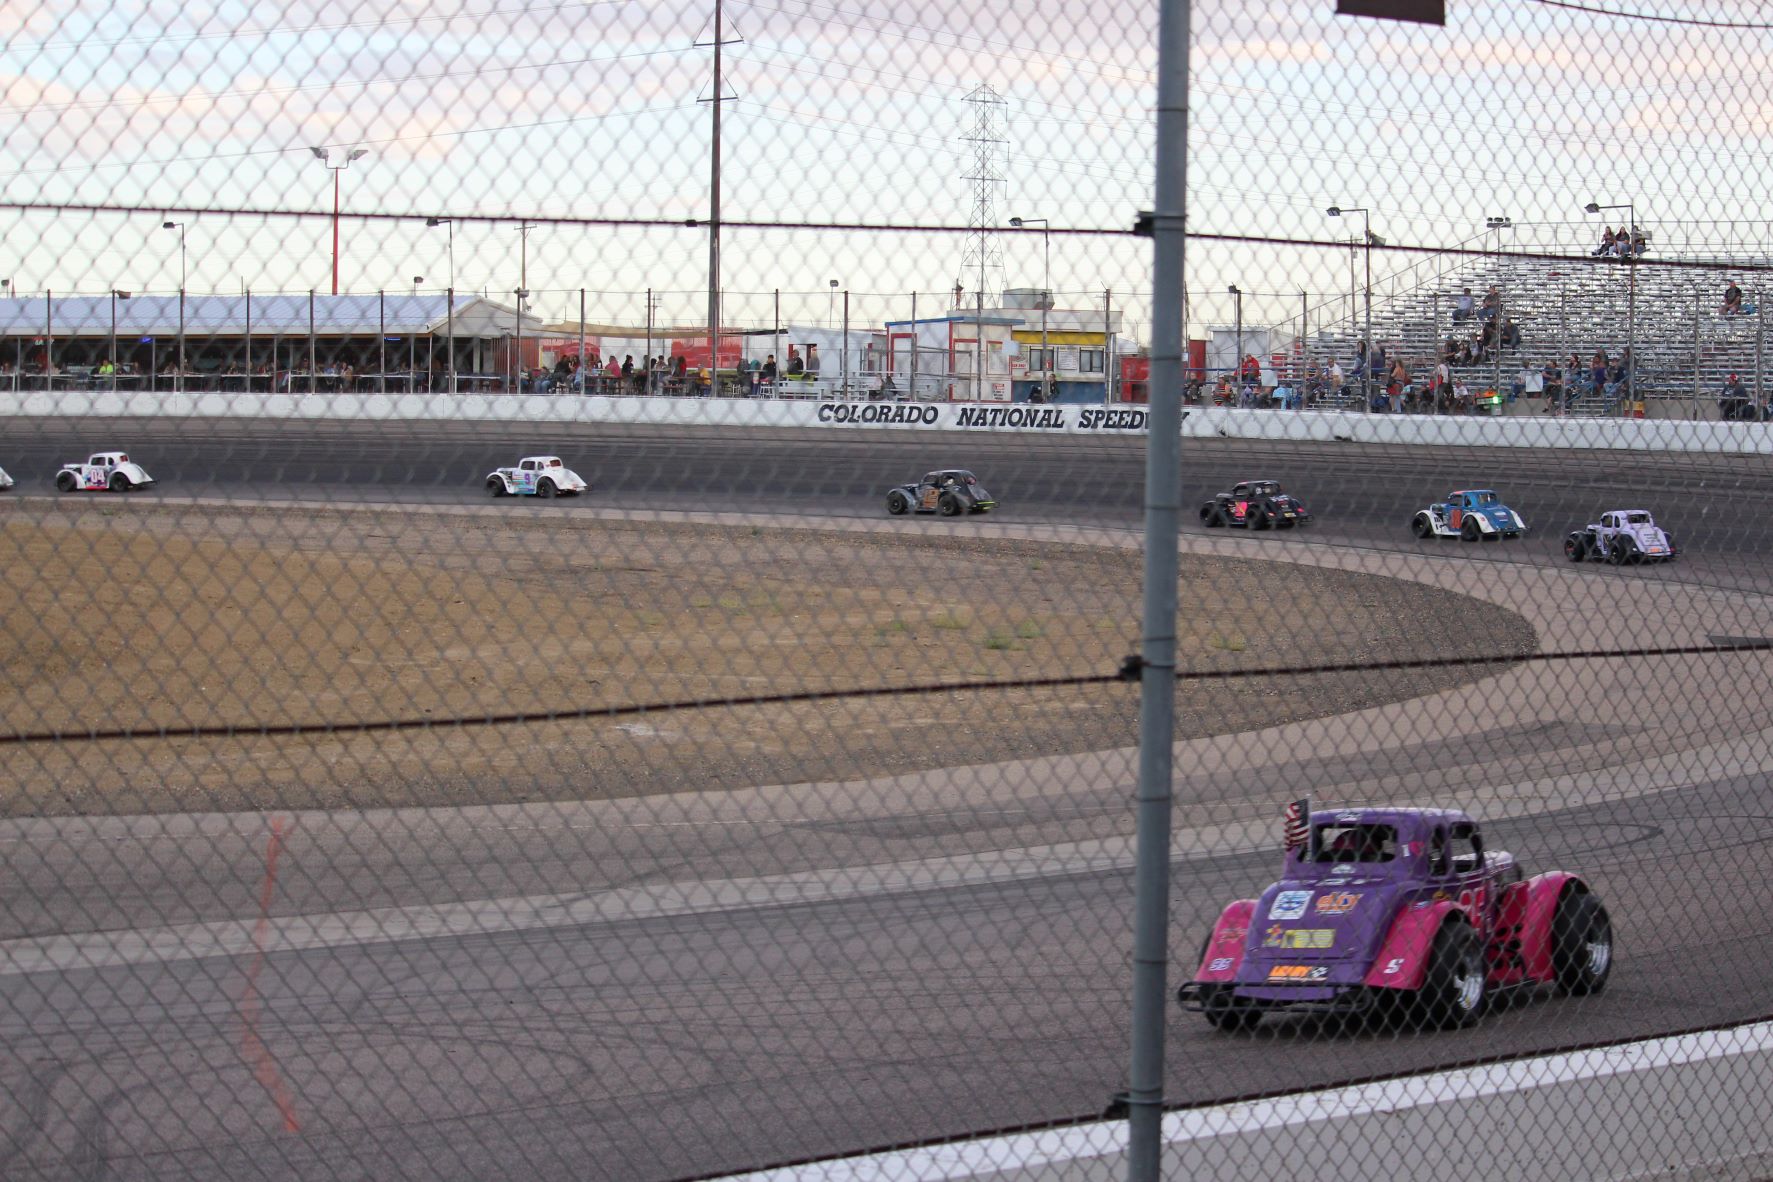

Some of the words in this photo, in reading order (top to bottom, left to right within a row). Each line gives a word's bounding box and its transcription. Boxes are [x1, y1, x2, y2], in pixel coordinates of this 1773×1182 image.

[818, 403, 939, 425] COLORADO
[956, 407, 1065, 429] NATIONAL
[1078, 409, 1191, 430] SPEED
